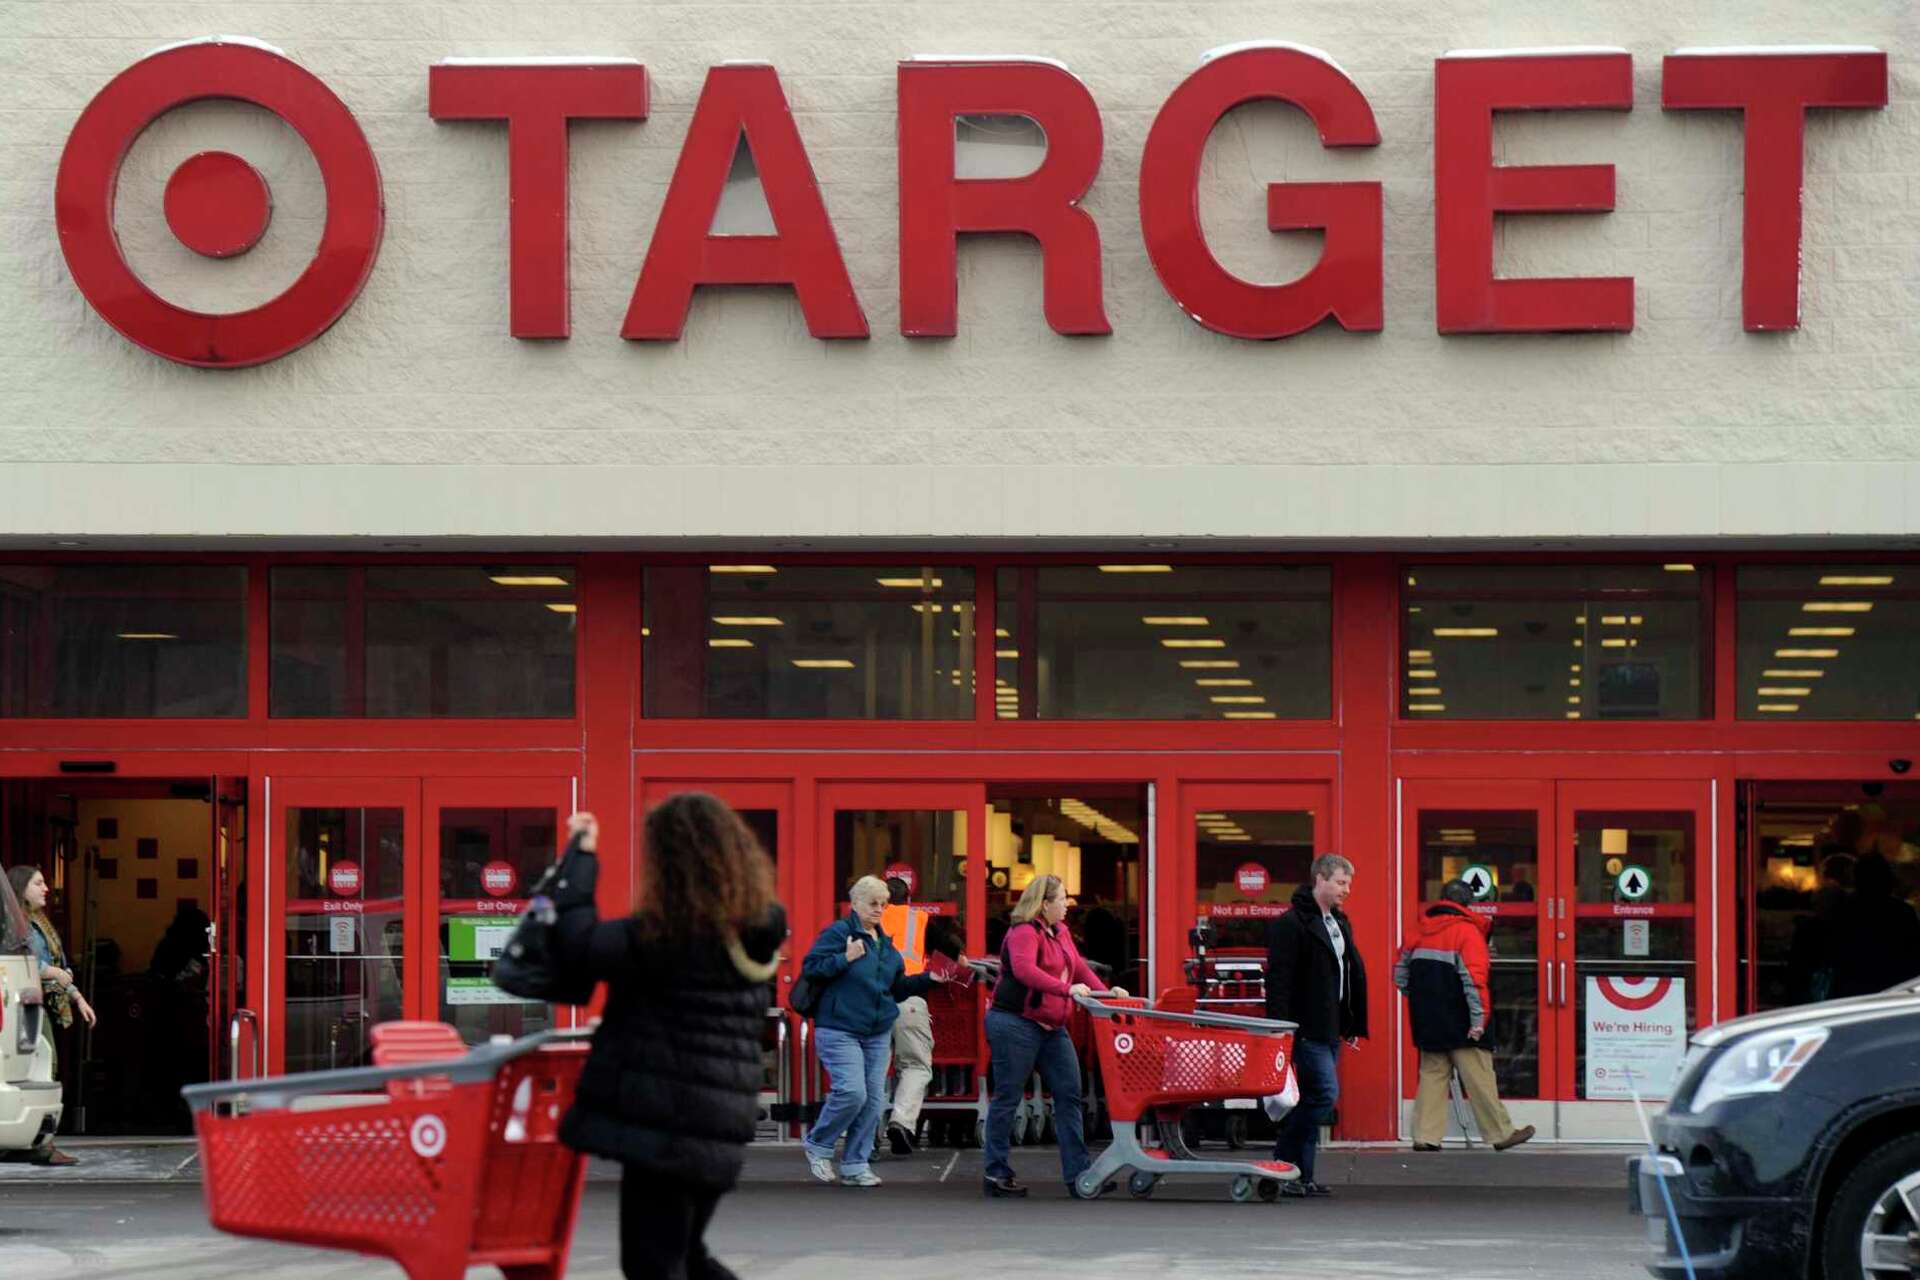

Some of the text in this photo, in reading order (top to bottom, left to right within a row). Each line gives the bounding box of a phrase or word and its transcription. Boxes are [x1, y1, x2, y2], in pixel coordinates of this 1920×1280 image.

[429, 44, 1889, 342] TARGET
[323, 901, 363, 913] Exit Only
[477, 901, 518, 912] Exit Only
[1213, 906, 1232, 915] Not
[1234, 907, 1248, 915] an
[1613, 904, 1654, 914] Entrance
[1592, 1021, 1673, 1036] We're Hiring
